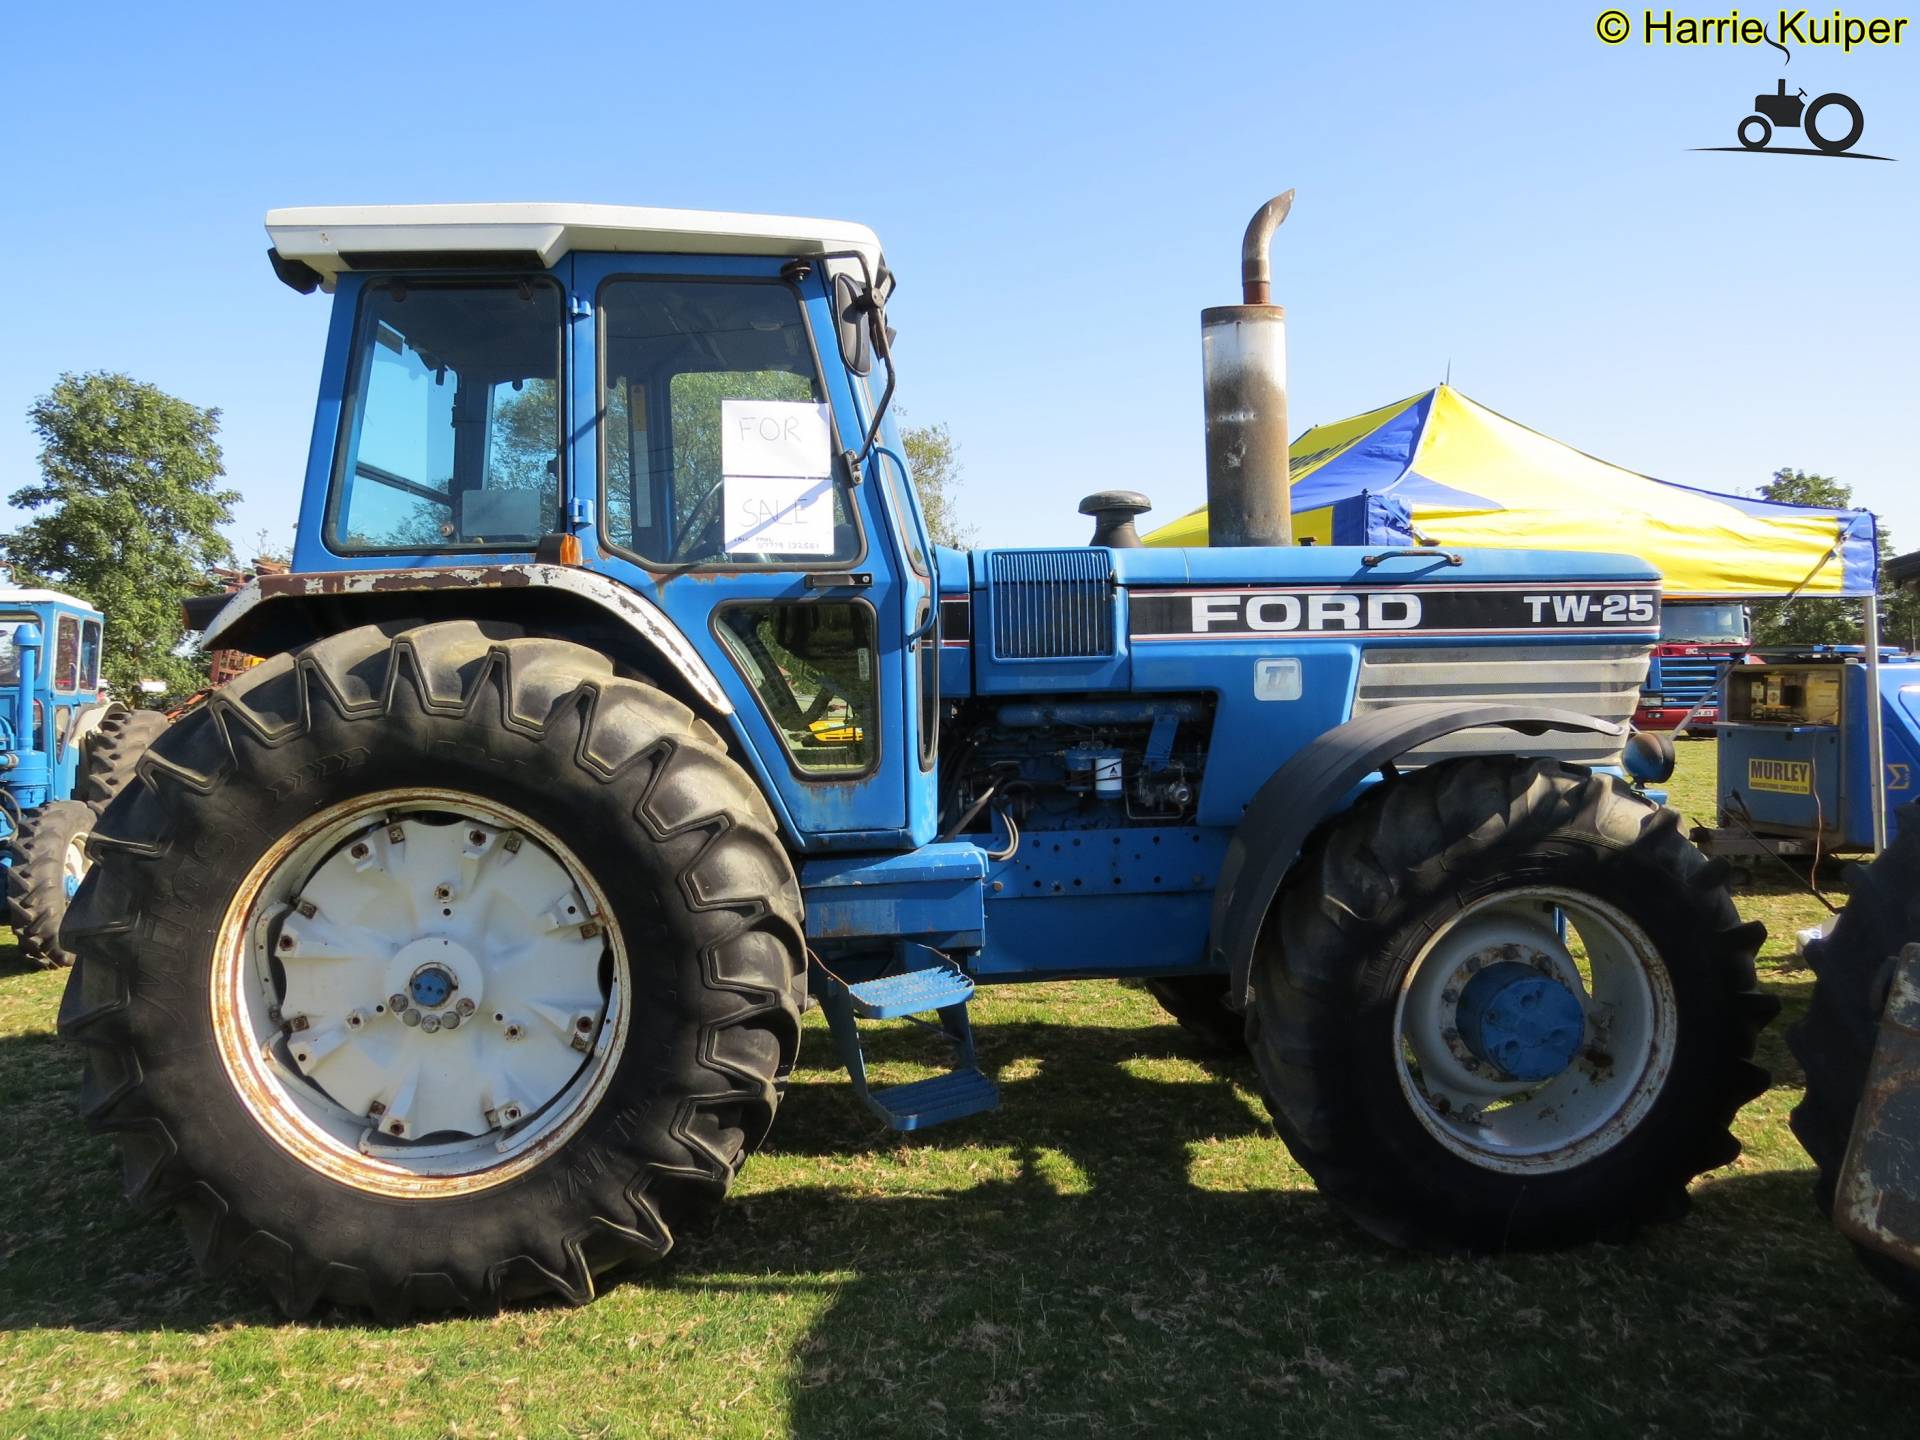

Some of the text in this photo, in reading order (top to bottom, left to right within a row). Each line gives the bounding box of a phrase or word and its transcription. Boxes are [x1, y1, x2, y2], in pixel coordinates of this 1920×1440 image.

[738, 416, 801, 441] FOR
[739, 498, 808, 527] SALE
[1191, 594, 1422, 632] FORD
[1523, 594, 1653, 622] TW-25
[1751, 760, 1809, 782] MURLEY
